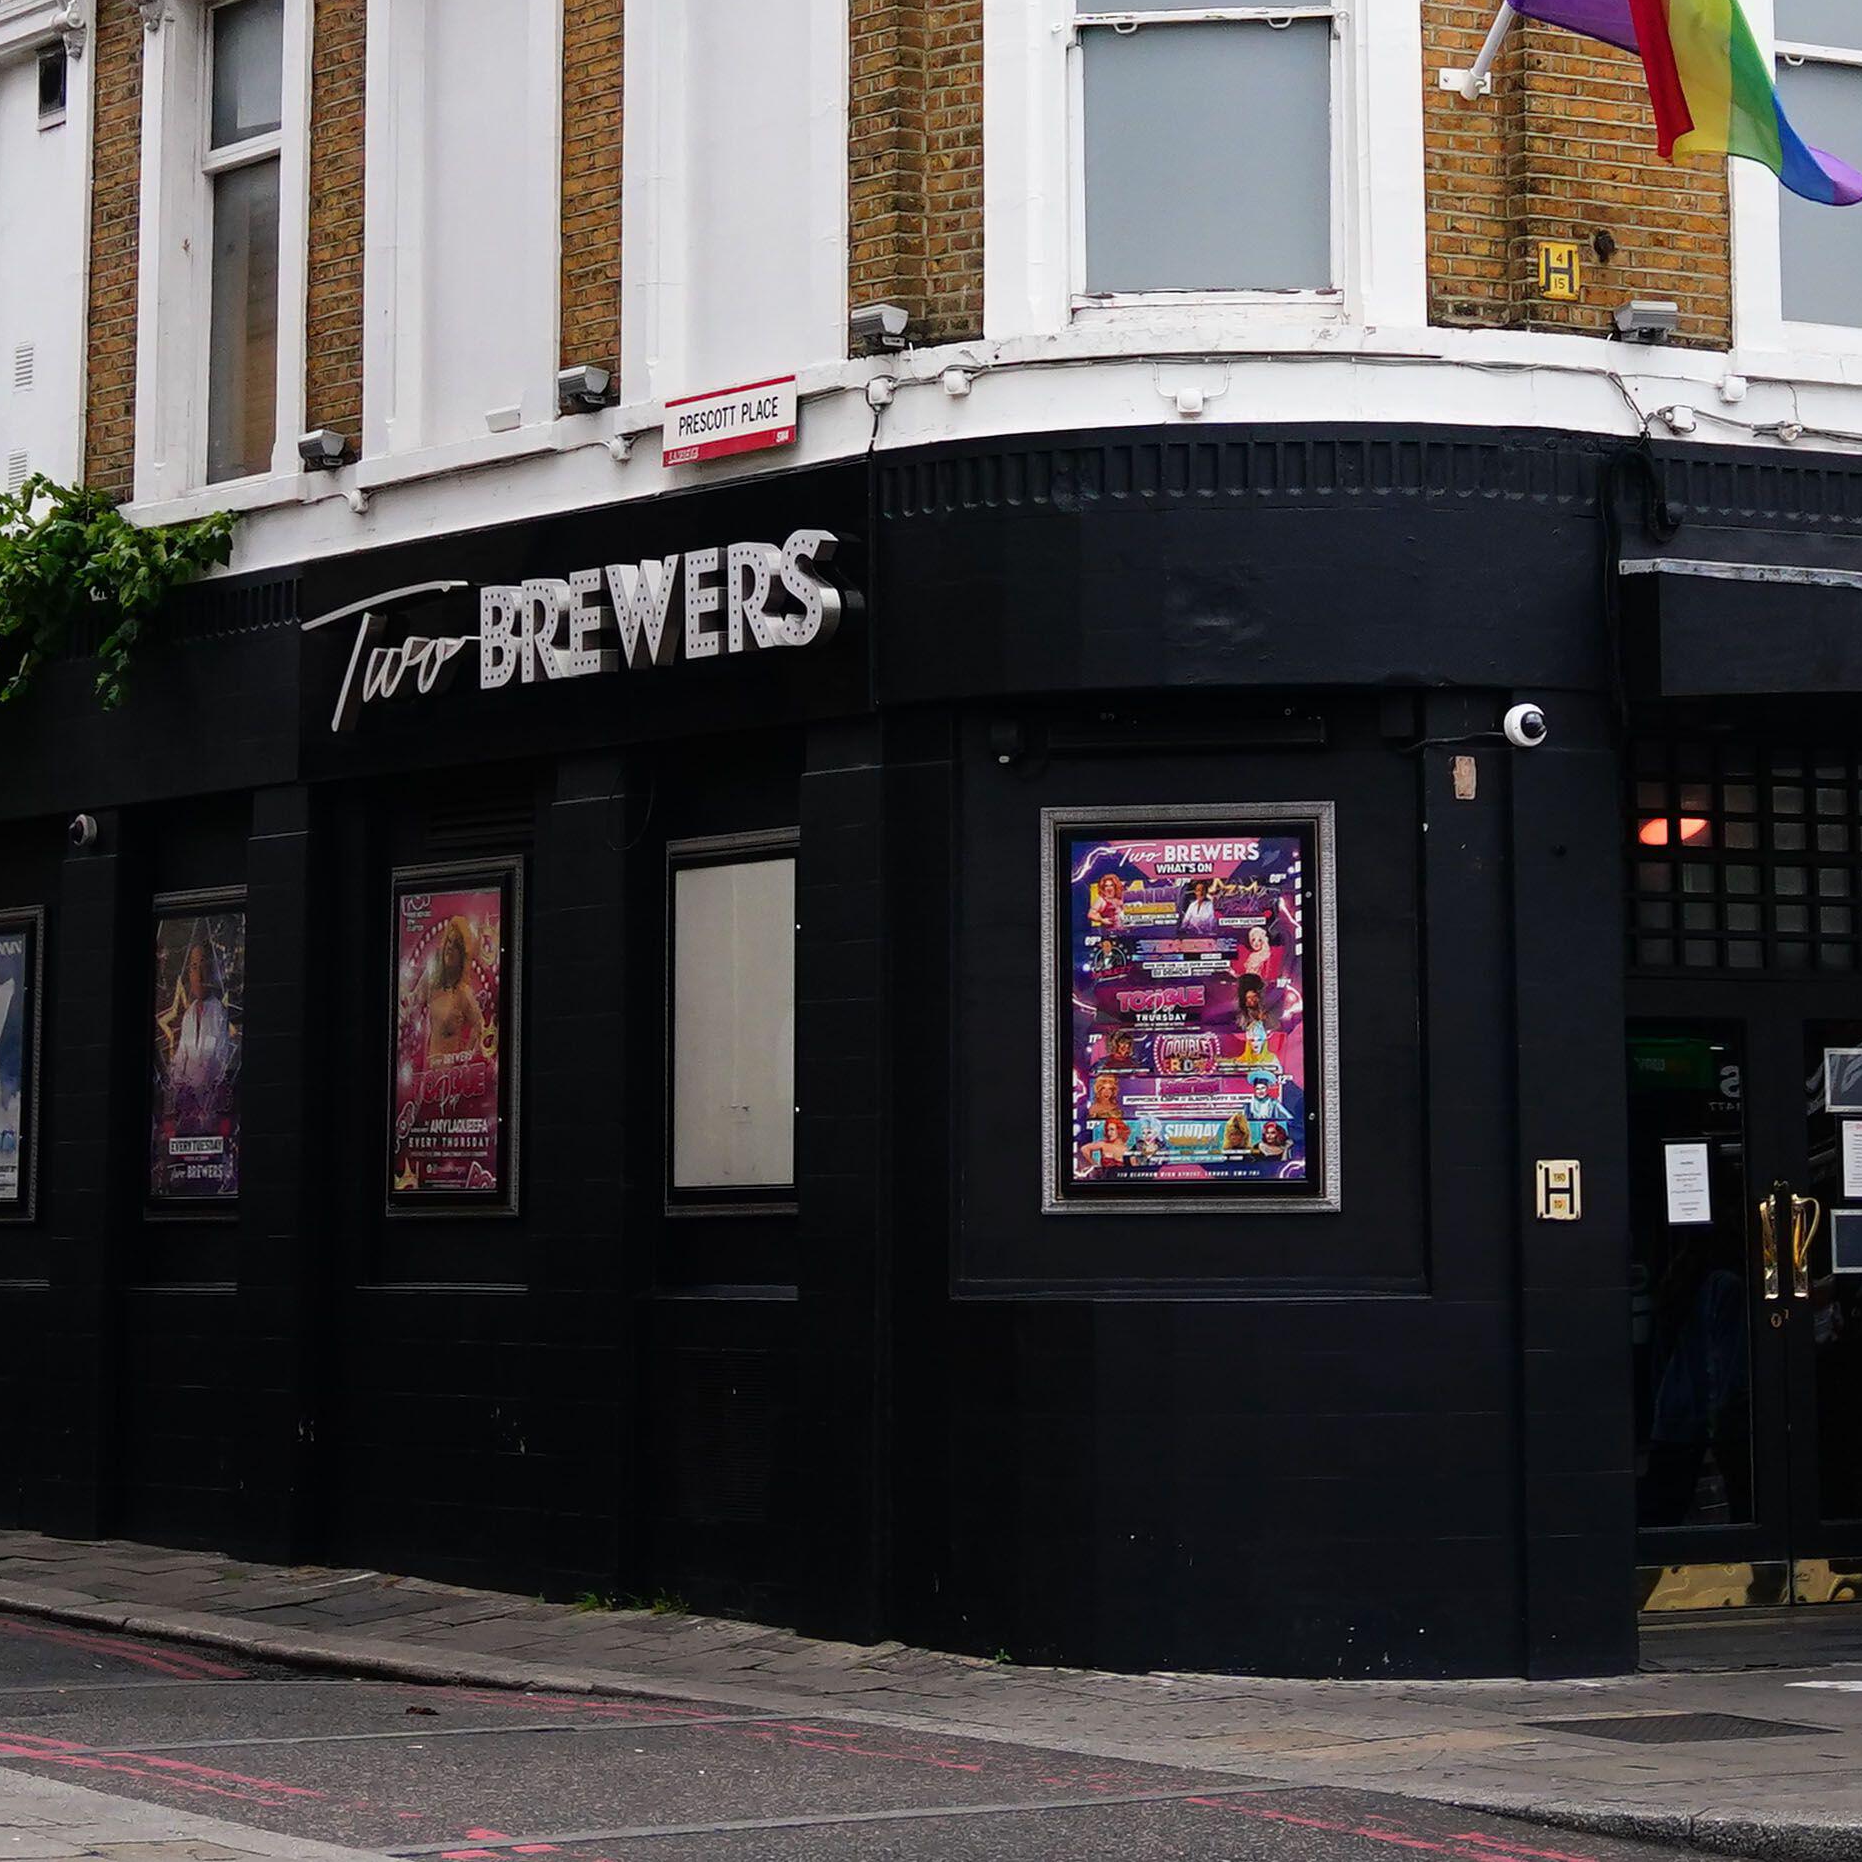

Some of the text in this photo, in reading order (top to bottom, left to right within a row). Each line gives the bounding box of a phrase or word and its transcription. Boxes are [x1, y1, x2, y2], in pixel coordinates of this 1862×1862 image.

[1556, 253, 1563, 264] 4
[1554, 278, 1566, 290] 15
[679, 396, 779, 437] PRESCOTT PLACE
[301, 529, 842, 731] Two BREWERS
[1118, 843, 1260, 867] Two BREWERS
[1156, 862, 1213, 874] WHAT'S ON
[1136, 1013, 1187, 1022] THURSDAY
[1165, 1123, 1221, 1138] SUNDAY
[442, 1136, 490, 1148] THURSDAY
